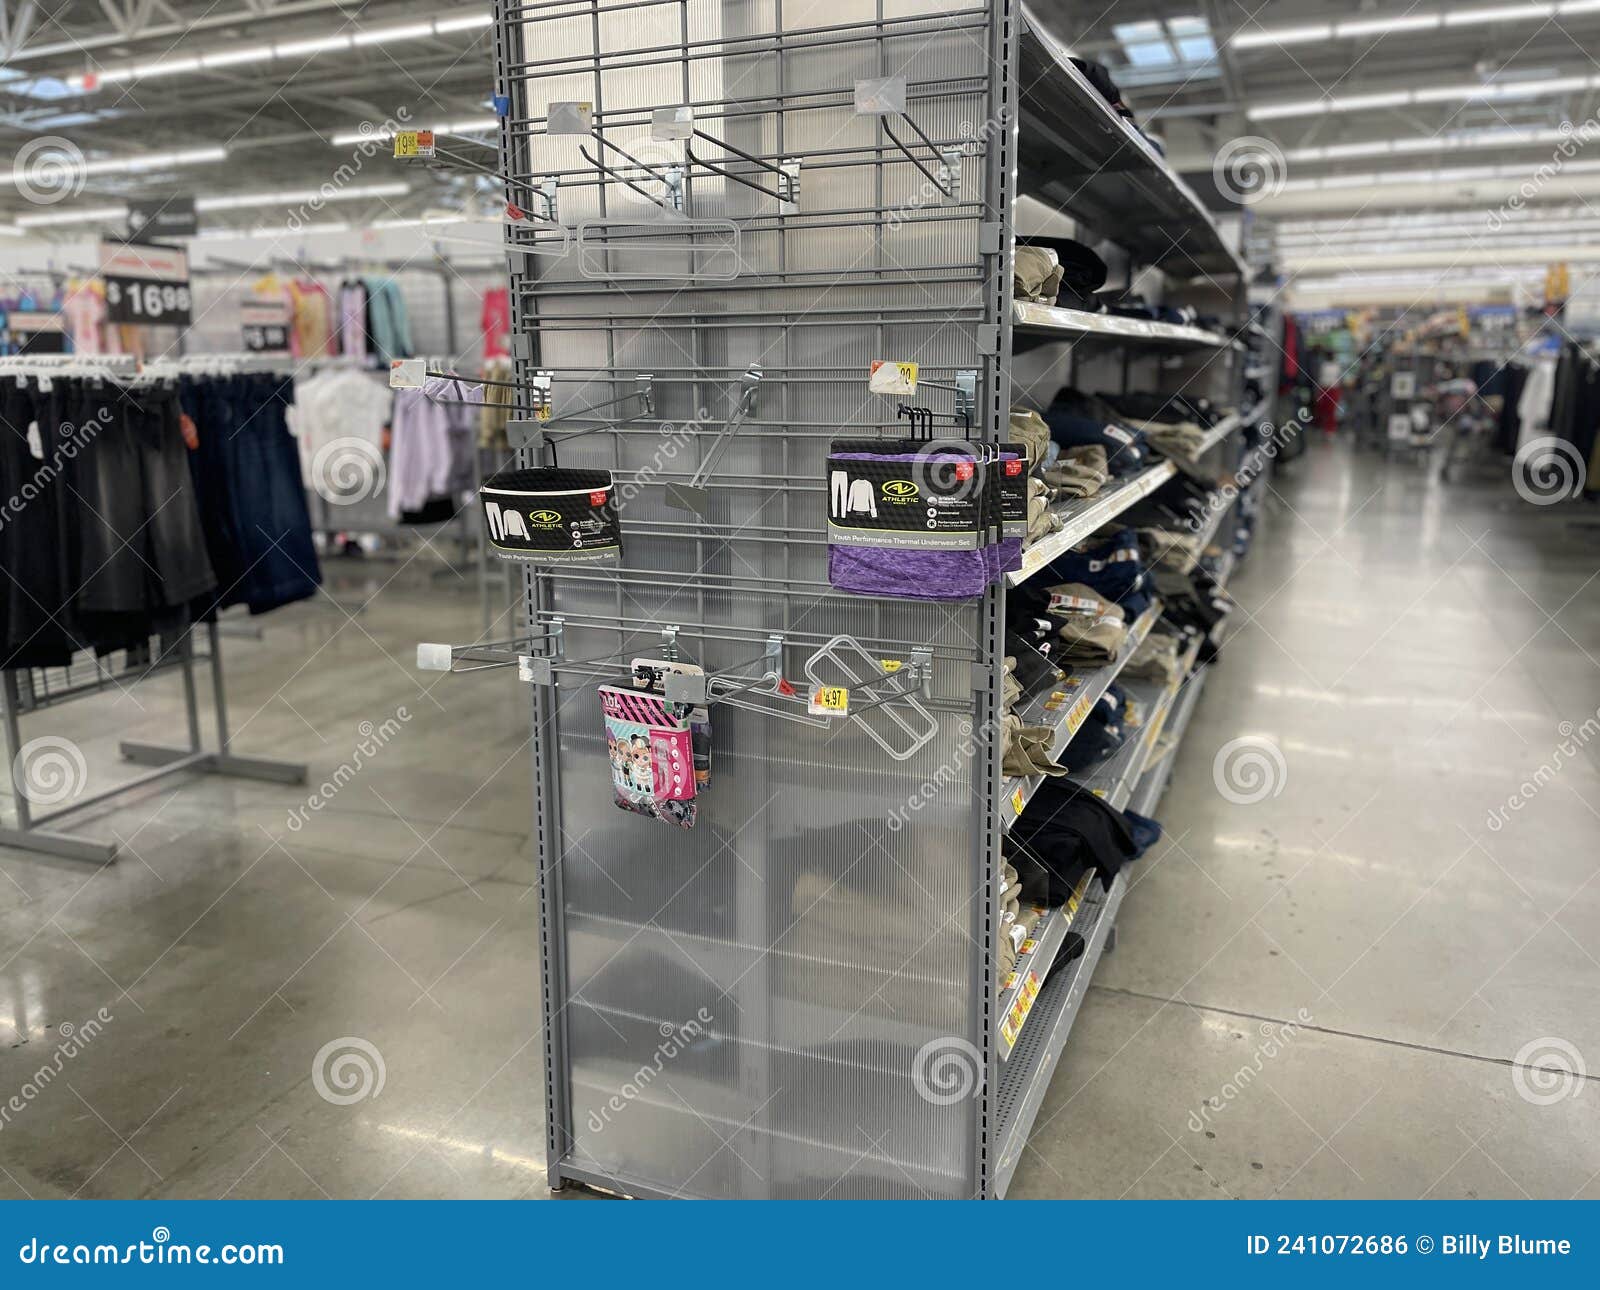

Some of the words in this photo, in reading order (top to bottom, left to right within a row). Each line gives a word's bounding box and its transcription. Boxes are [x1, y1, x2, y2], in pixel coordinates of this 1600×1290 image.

[833, 533, 852, 542] Youth
[852, 535, 893, 545] Performance
[893, 537, 919, 546] Thermal
[920, 538, 958, 546] Underwear
